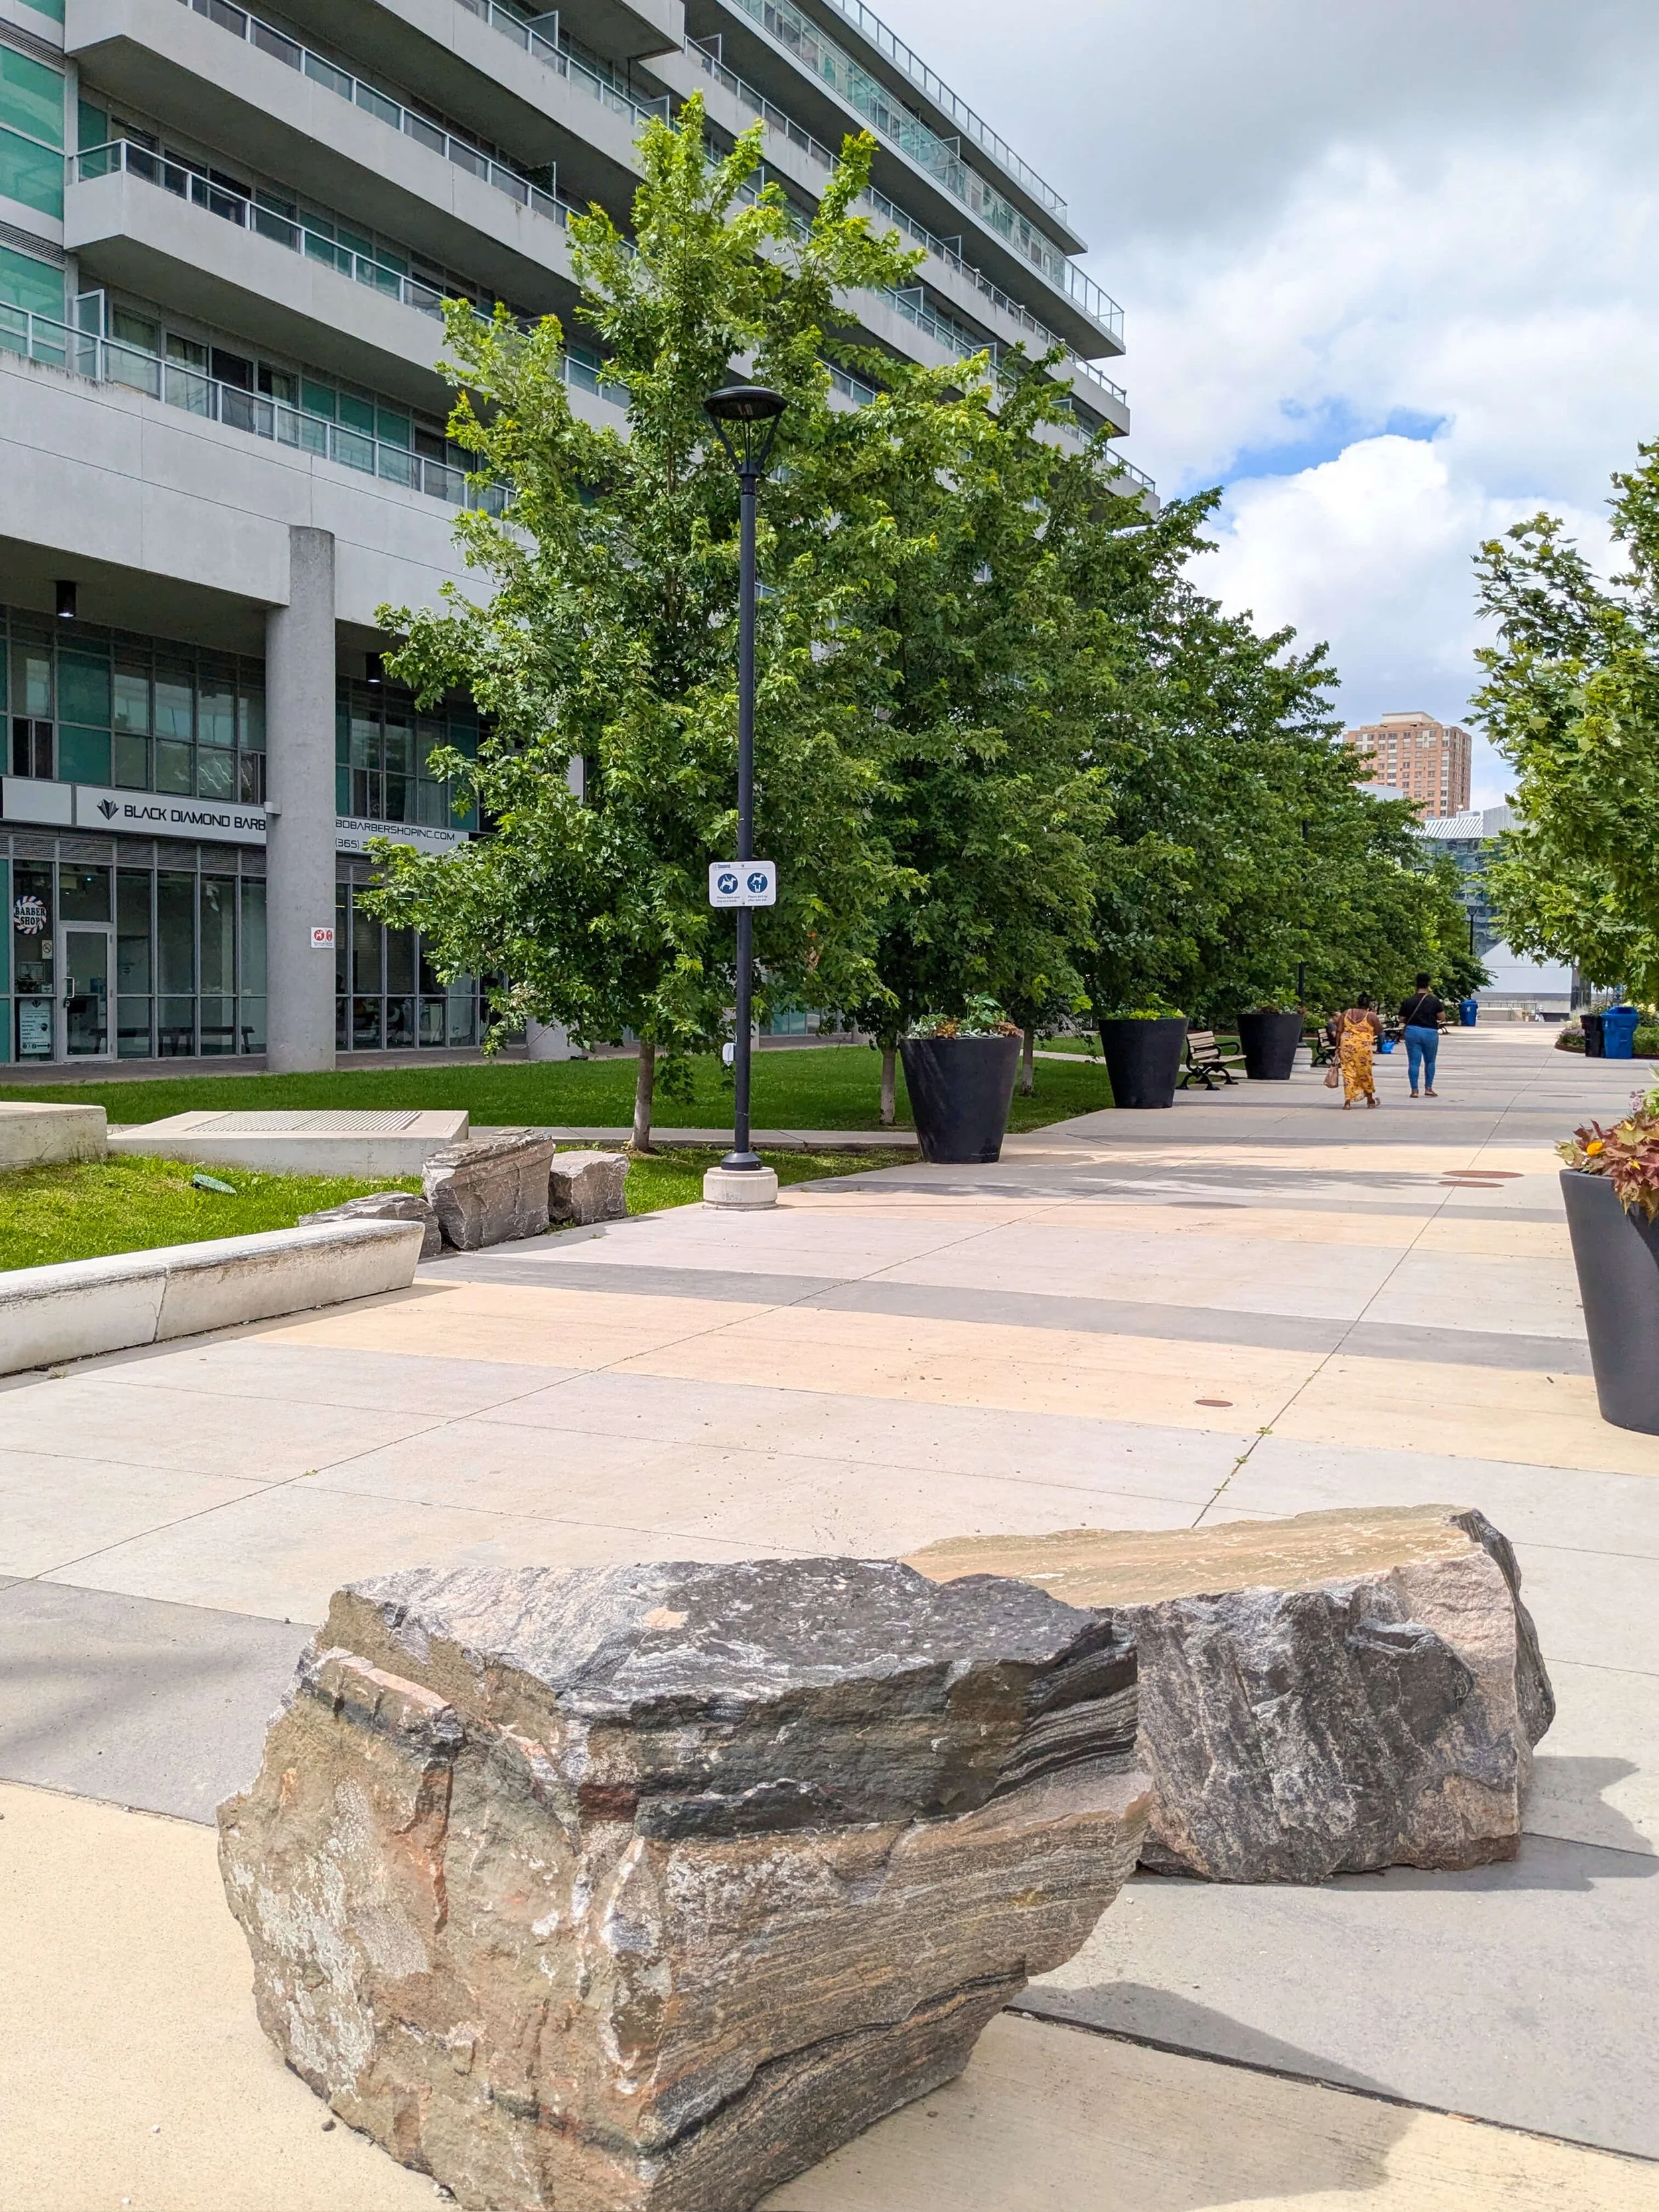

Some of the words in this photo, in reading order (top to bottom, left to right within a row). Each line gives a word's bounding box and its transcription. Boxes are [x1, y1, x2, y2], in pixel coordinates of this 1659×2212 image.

[124, 804, 167, 822] BLACK
[171, 809, 230, 828] DIAMOND
[335, 837, 360, 850] (365)
[15, 907, 45, 917] BARBER
[20, 916, 40, 926] SHOP
